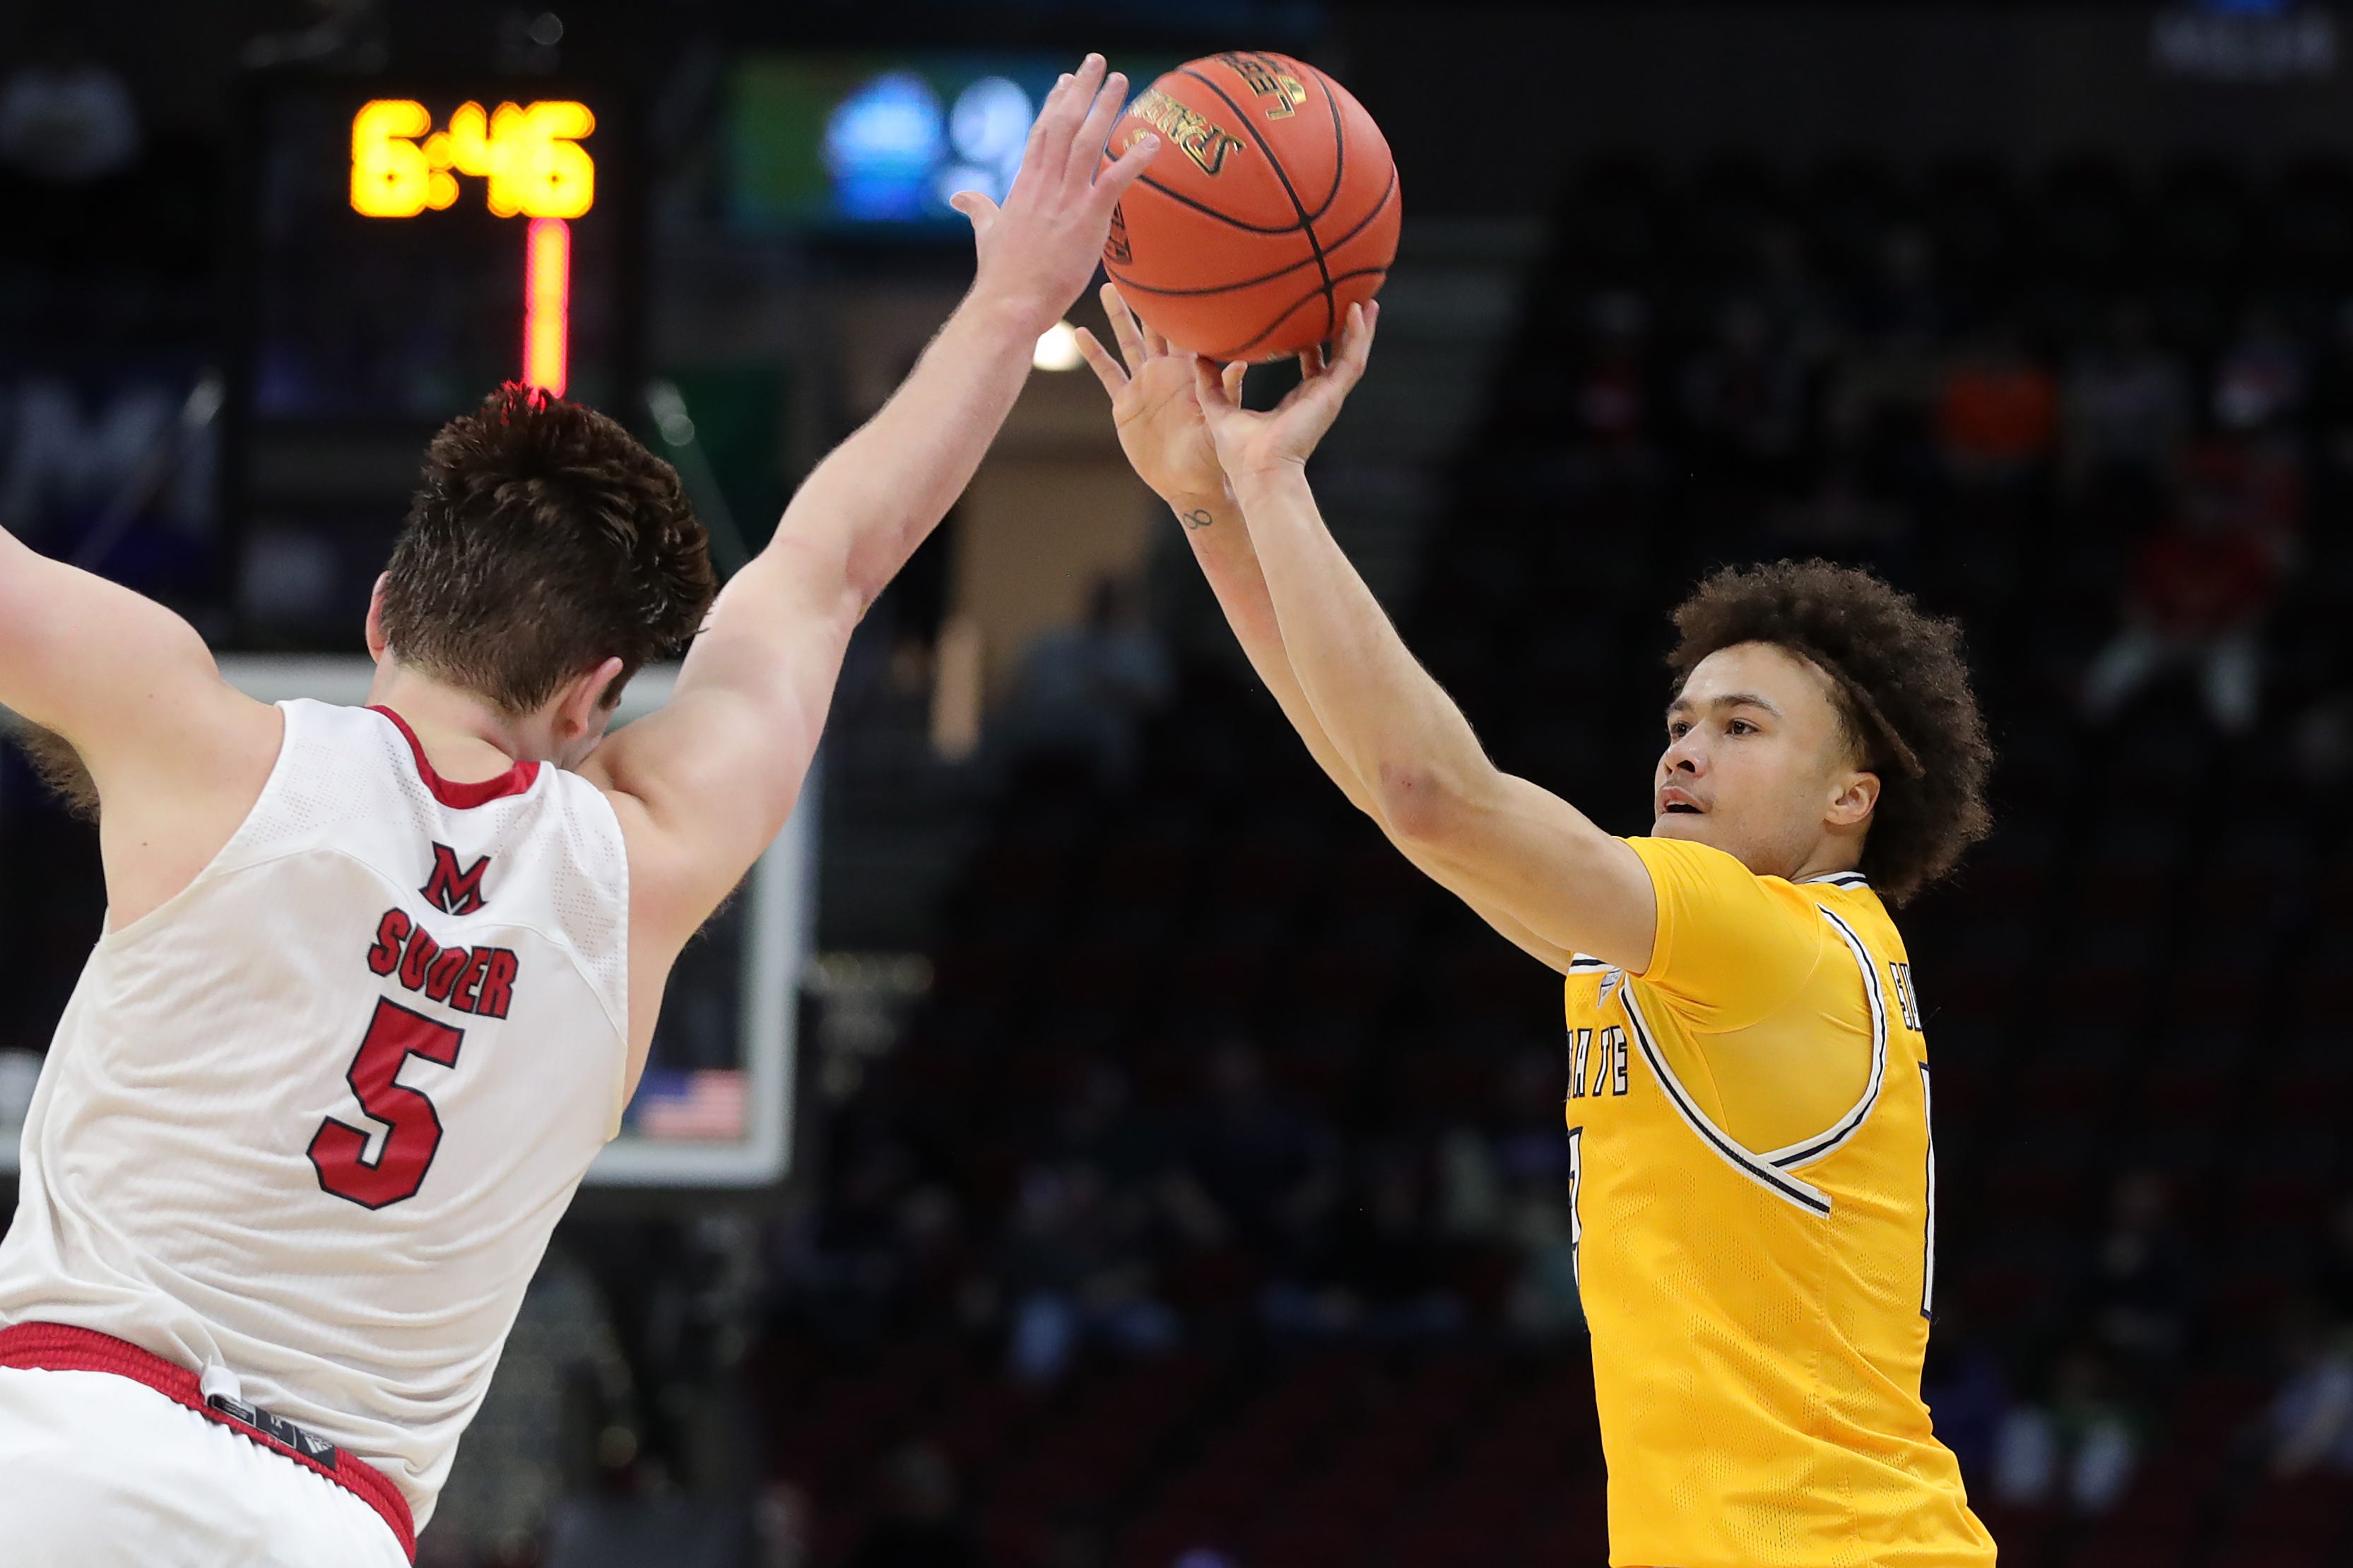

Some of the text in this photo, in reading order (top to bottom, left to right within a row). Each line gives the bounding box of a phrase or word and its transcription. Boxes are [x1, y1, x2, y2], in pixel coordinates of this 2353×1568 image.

[351, 99, 596, 219] 6:46
[418, 840, 493, 916] M
[367, 907, 519, 1020] SUDER
[306, 994, 466, 1210] 5
